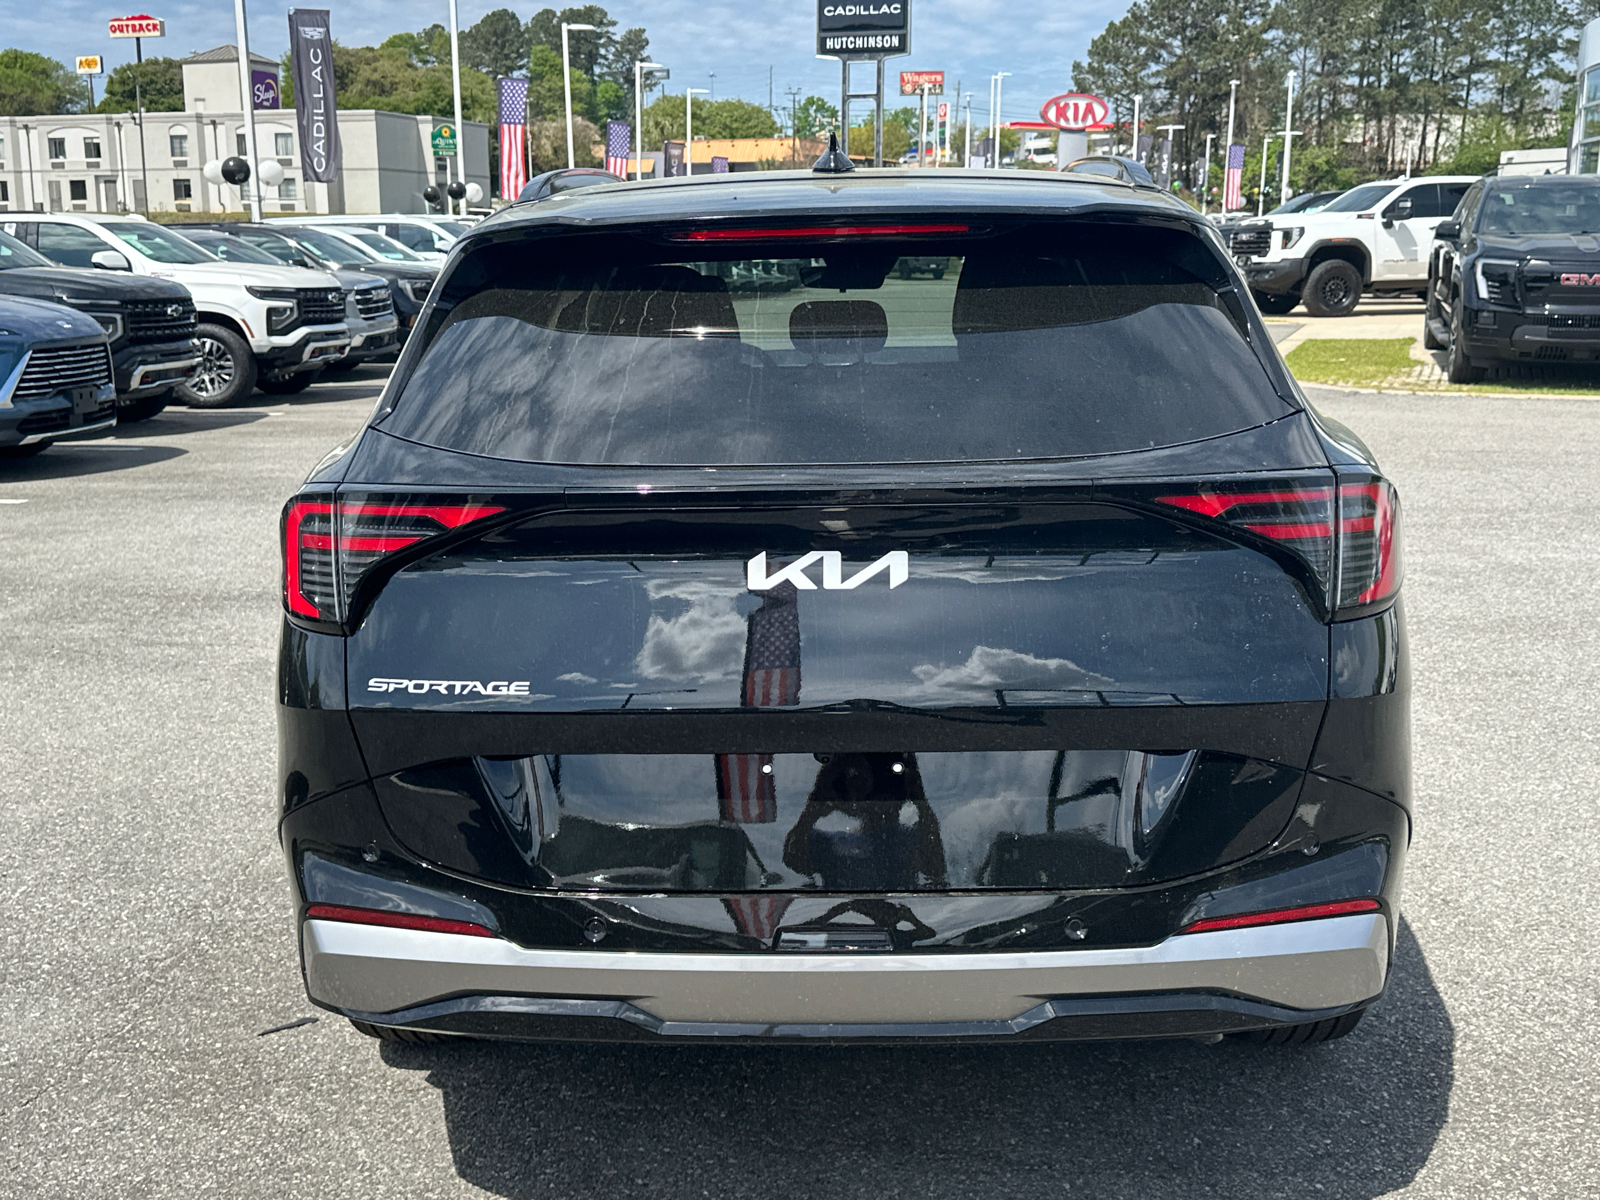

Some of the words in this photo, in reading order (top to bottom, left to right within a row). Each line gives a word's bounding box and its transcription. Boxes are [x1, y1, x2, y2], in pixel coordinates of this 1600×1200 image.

[823, 3, 902, 17] CADILLAC
[109, 22, 160, 34] OUTBACK
[826, 35, 900, 50] HUTCHINSON
[902, 72, 943, 84] Wagers
[253, 83, 275, 104] Sleep
[310, 47, 326, 173] CADILLAC
[1055, 101, 1097, 124] KIA
[1560, 273, 1600, 286] GM
[747, 550, 909, 591] KIA
[367, 677, 531, 696] SPORTAGE
